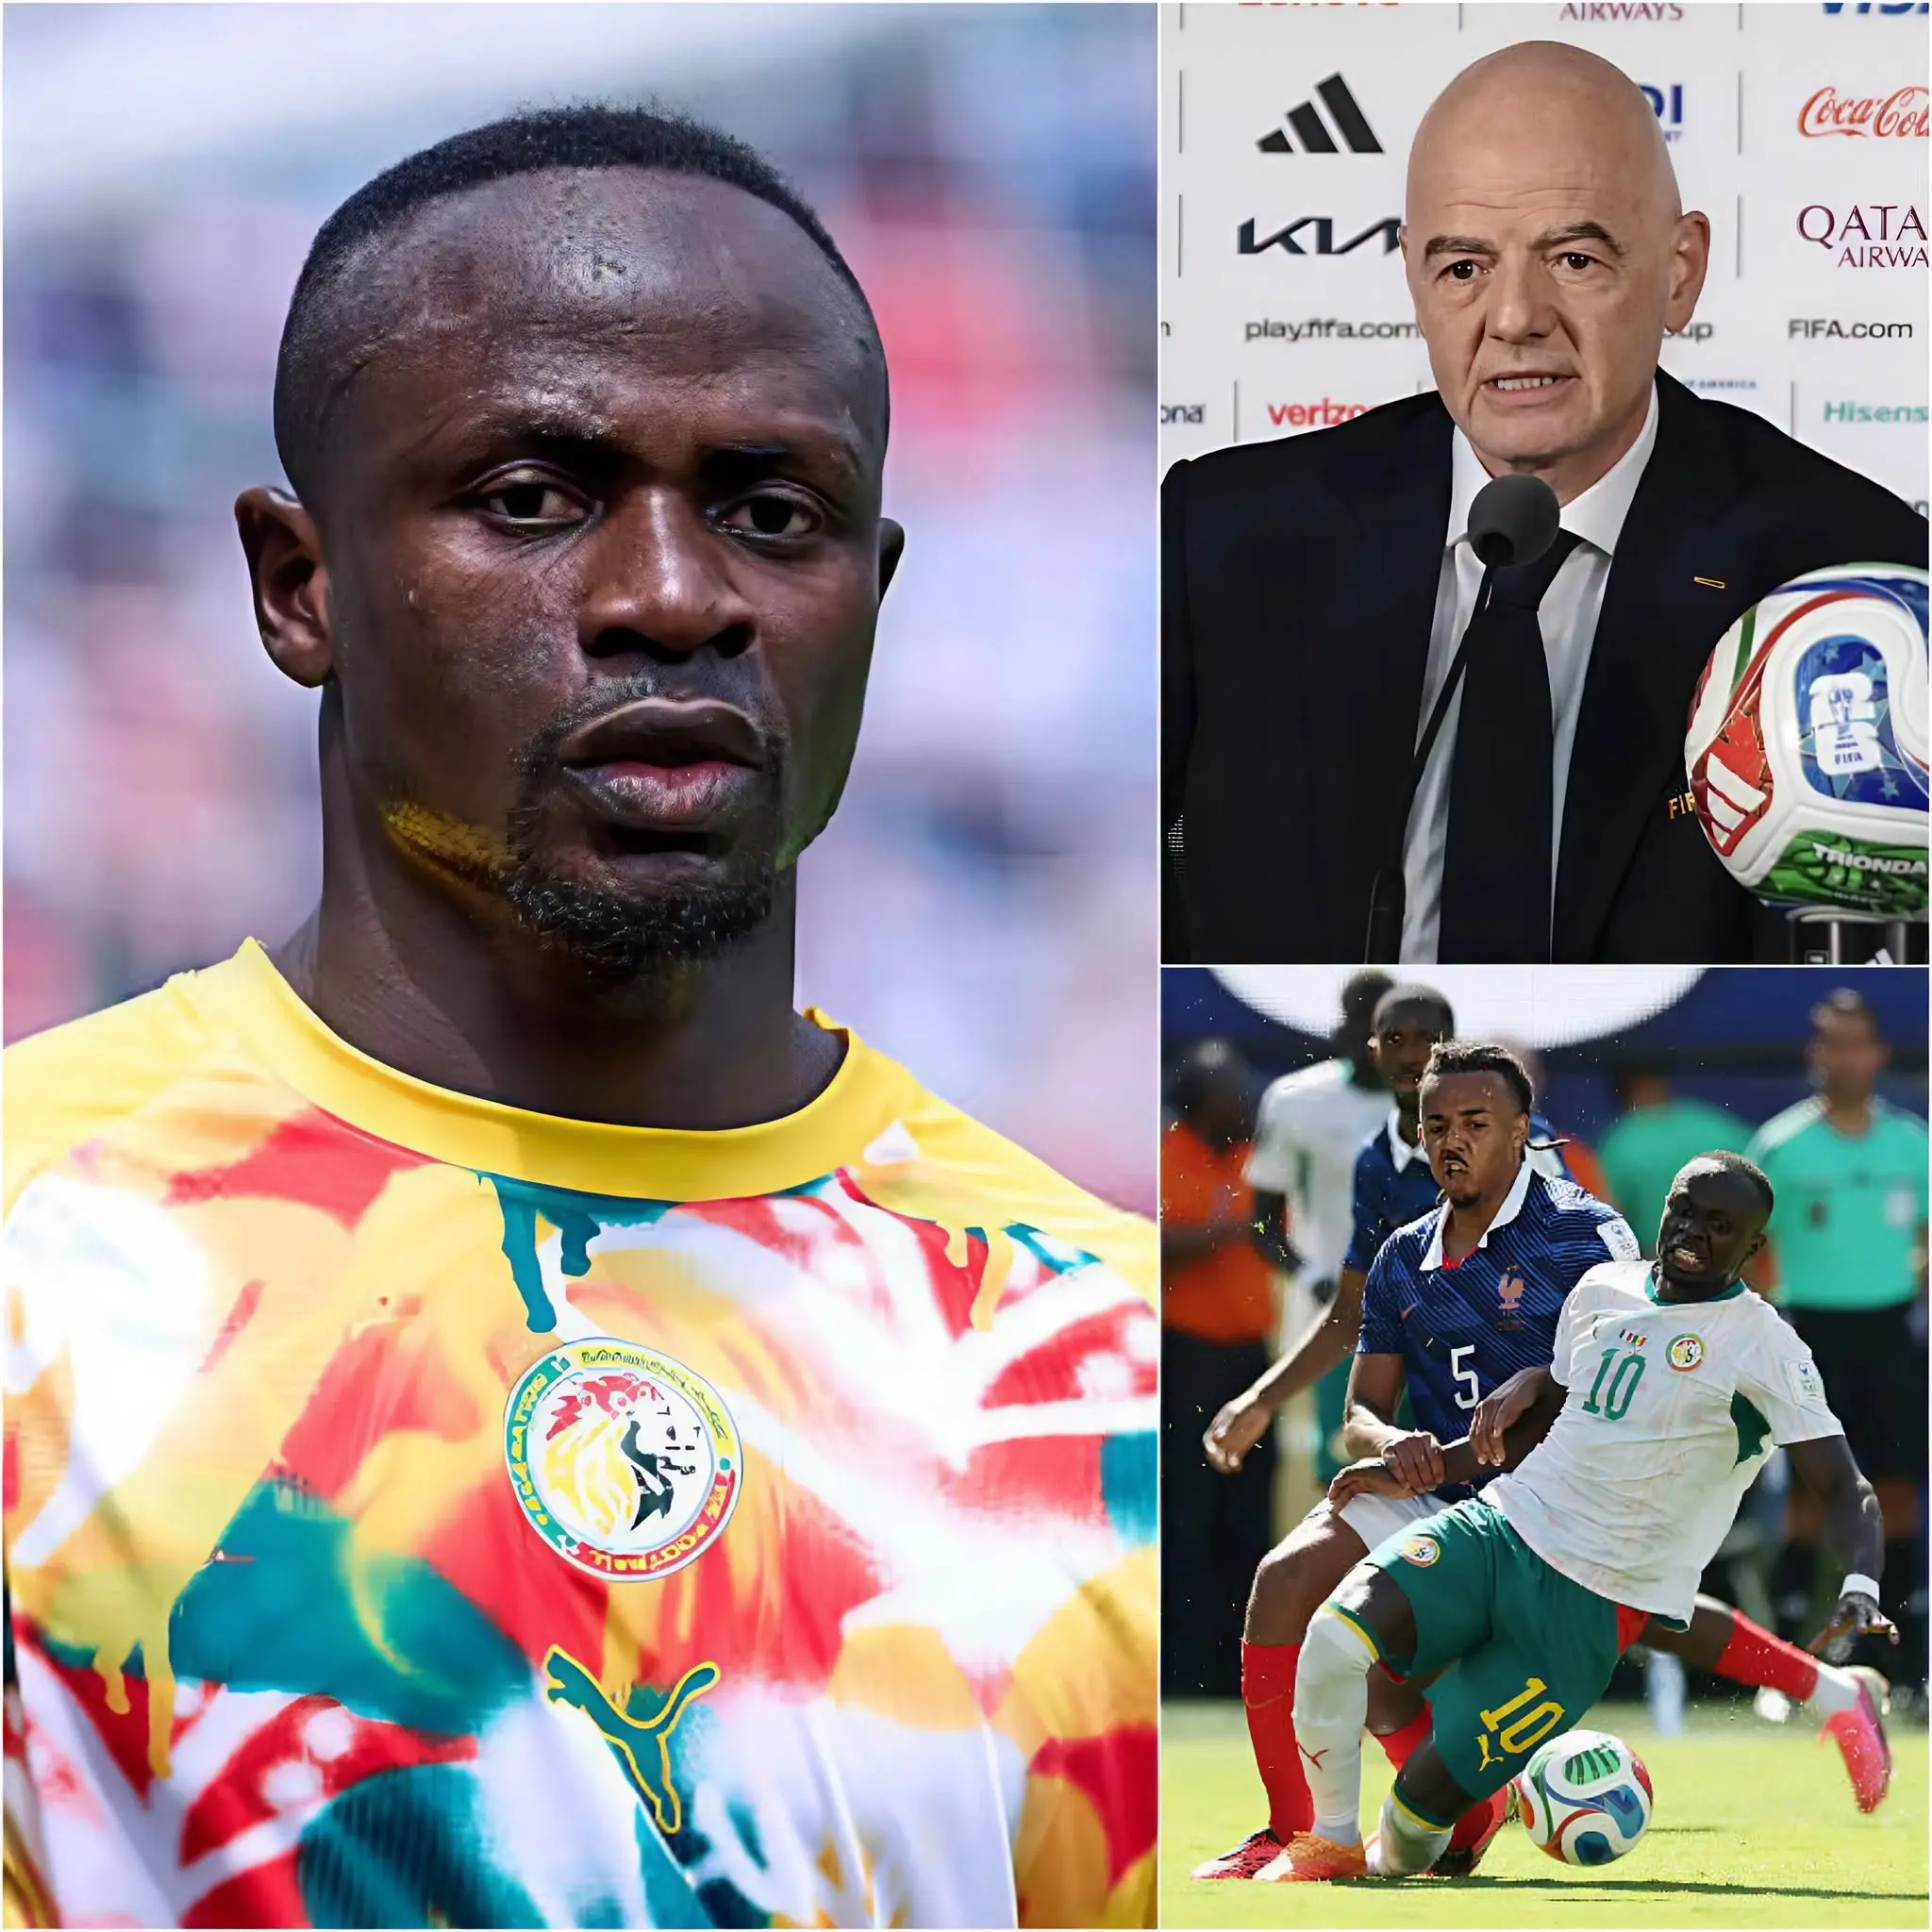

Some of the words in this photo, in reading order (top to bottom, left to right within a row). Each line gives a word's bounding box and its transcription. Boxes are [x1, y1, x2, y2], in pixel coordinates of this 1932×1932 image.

[1796, 204, 1928, 250] QATA
[1837, 246, 1929, 268] AIRWA
[1788, 319, 1913, 340] FIFA.com
[1812, 841, 1927, 875] TRIONDA
[1451, 1344, 1481, 1410] 5
[1581, 1348, 1646, 1421] 10
[1478, 1676, 1566, 1755] 10
